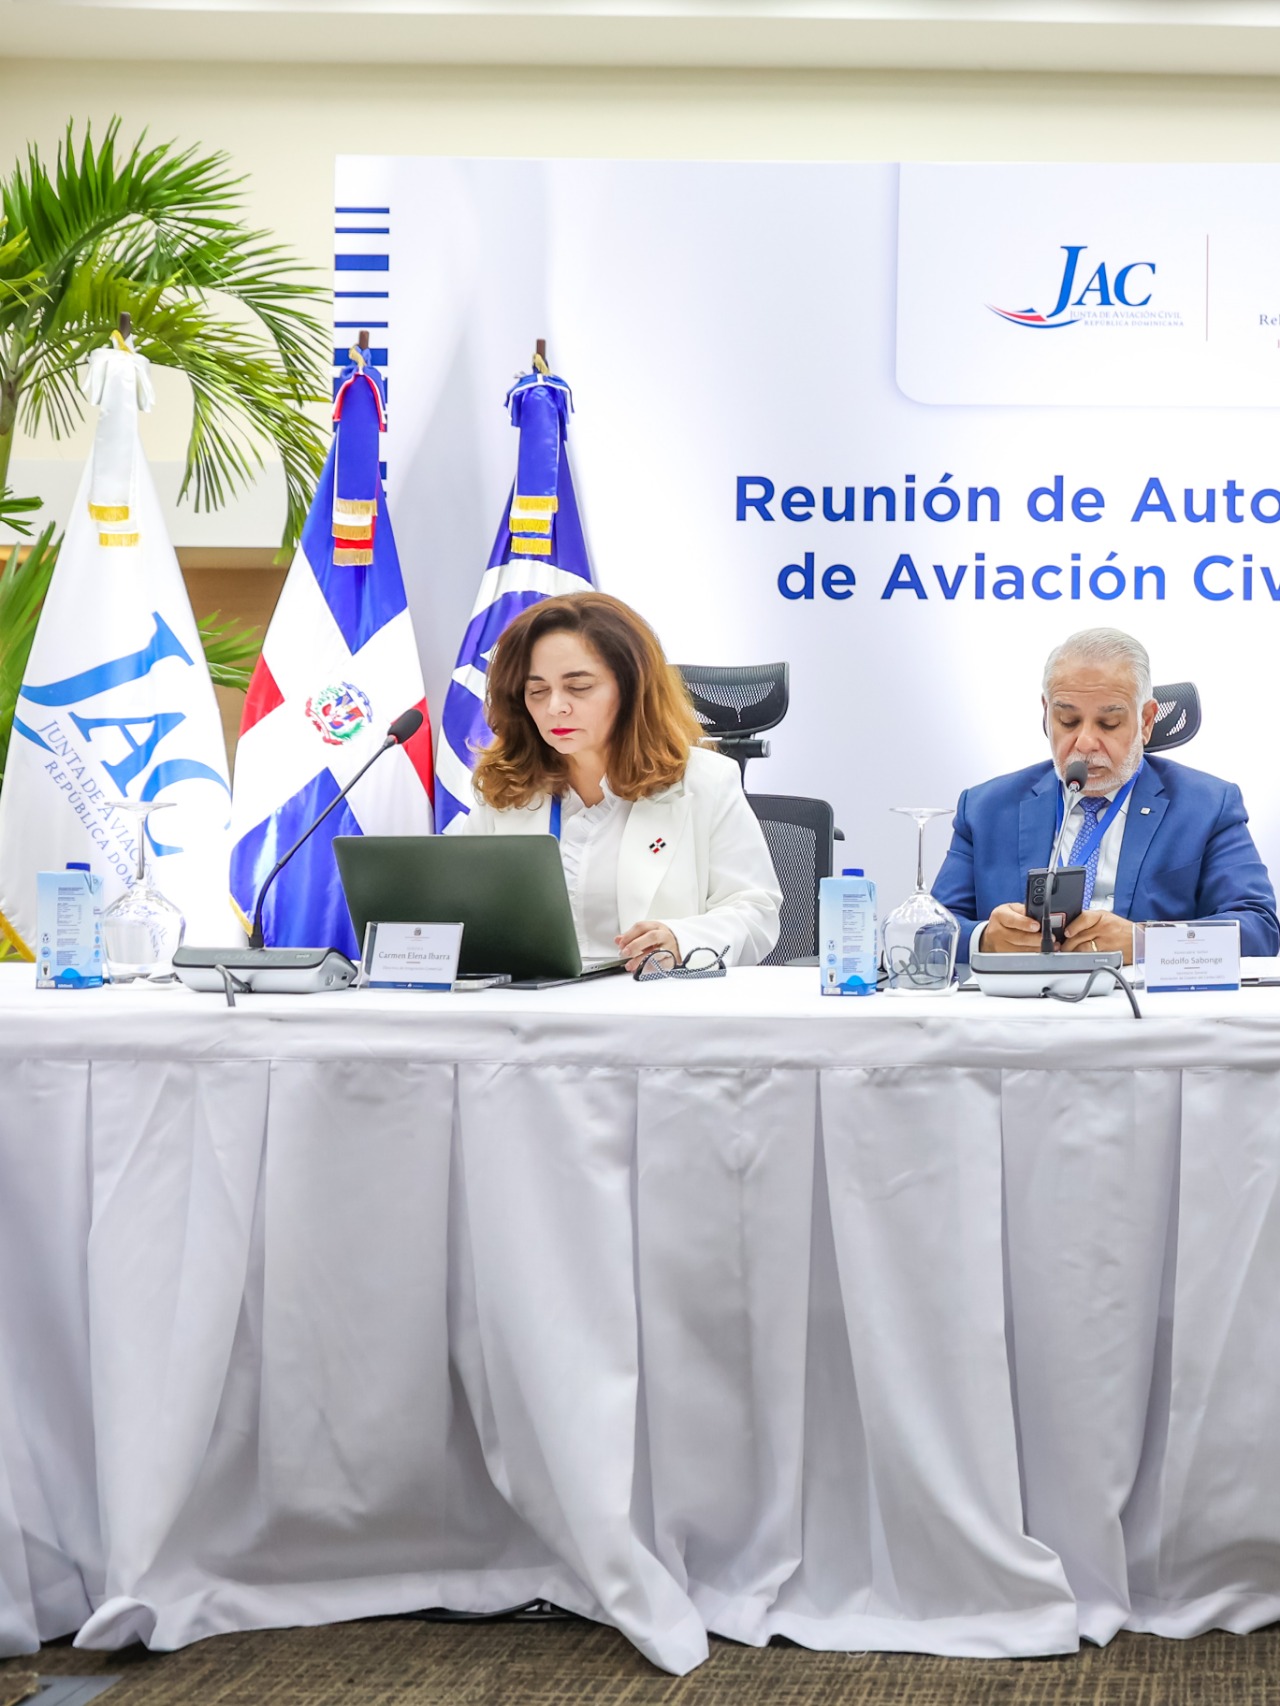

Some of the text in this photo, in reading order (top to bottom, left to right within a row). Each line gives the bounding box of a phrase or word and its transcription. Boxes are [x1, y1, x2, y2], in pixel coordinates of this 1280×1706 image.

[1046, 246, 1156, 318] JAC
[1070, 310, 1098, 319] JUNTA
[1112, 310, 1156, 319] AVIACIÓN
[1157, 310, 1182, 319] CIVIL
[736, 472, 1000, 522] Reunión
[1027, 475, 1106, 522] de
[777, 552, 856, 600] de
[881, 551, 1166, 601] Aviación
[19, 610, 232, 858] JAC
[37, 720, 88, 780] JUNTA
[81, 778, 105, 804] DE
[45, 760, 110, 850] REPÚBLICA
[378, 951, 406, 959] Carmen
[407, 952, 427, 960] Elena
[1160, 957, 1189, 965] Rodolfo
